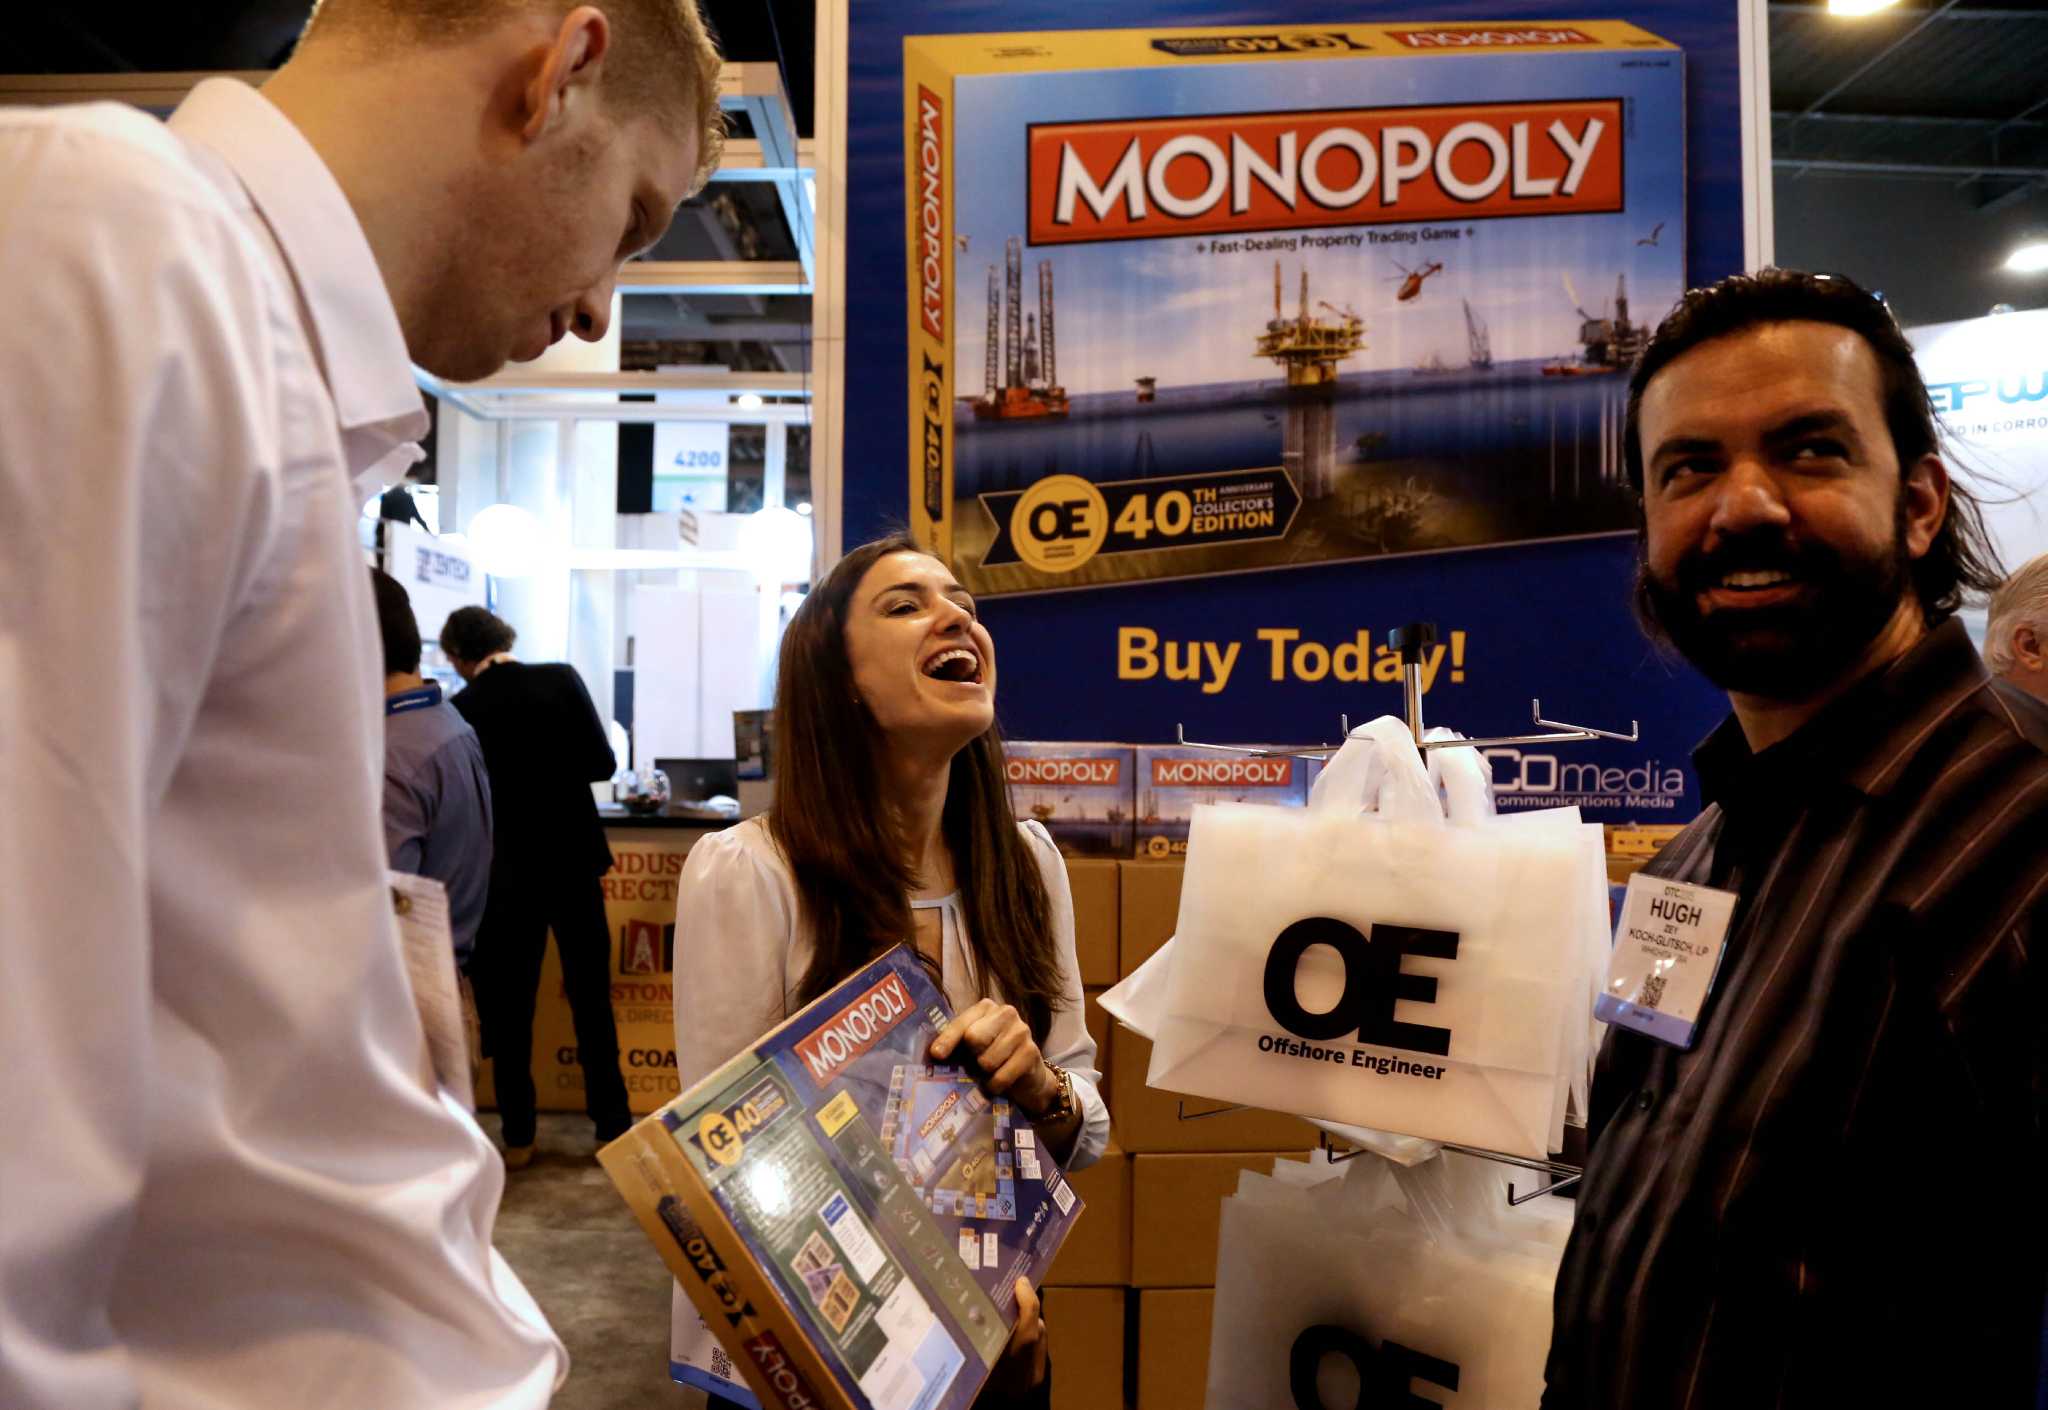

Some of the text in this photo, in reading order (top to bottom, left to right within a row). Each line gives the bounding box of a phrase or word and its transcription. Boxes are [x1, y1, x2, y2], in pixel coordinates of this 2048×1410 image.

[1054, 117, 1605, 225] MONOPOLY
[920, 99, 942, 333] MONOPOLY
[1210, 227, 1460, 254] Fast-Dealing Property Trading Game
[1925, 370, 2048, 413] EPW
[1993, 416, 2048, 433] CORRO
[674, 450, 721, 467] 4200
[1028, 498, 1091, 542] OE
[1113, 489, 1192, 539] 40
[1193, 497, 1275, 515] COLLECTOR'S
[1192, 510, 1274, 534] EDITION
[1118, 626, 1466, 695] Buy Today!
[1007, 760, 1114, 782] ONOPOLY
[1158, 762, 1287, 783] MONOPOLY
[1496, 794, 1675, 808] ommunications Media
[605, 852, 687, 875] NDUS
[602, 879, 678, 902] RECT
[1650, 897, 1702, 927] HUGH
[1263, 915, 1460, 1055] OE
[627, 1008, 673, 1024] DIREC
[803, 978, 907, 1078] MONOPOLY
[628, 1049, 678, 1068] COA
[1258, 1034, 1446, 1080] Offshore Engineer
[707, 1101, 761, 1151] OE 40
[919, 1089, 960, 1138] MONOPOLY
[751, 1343, 813, 1410] POLY
